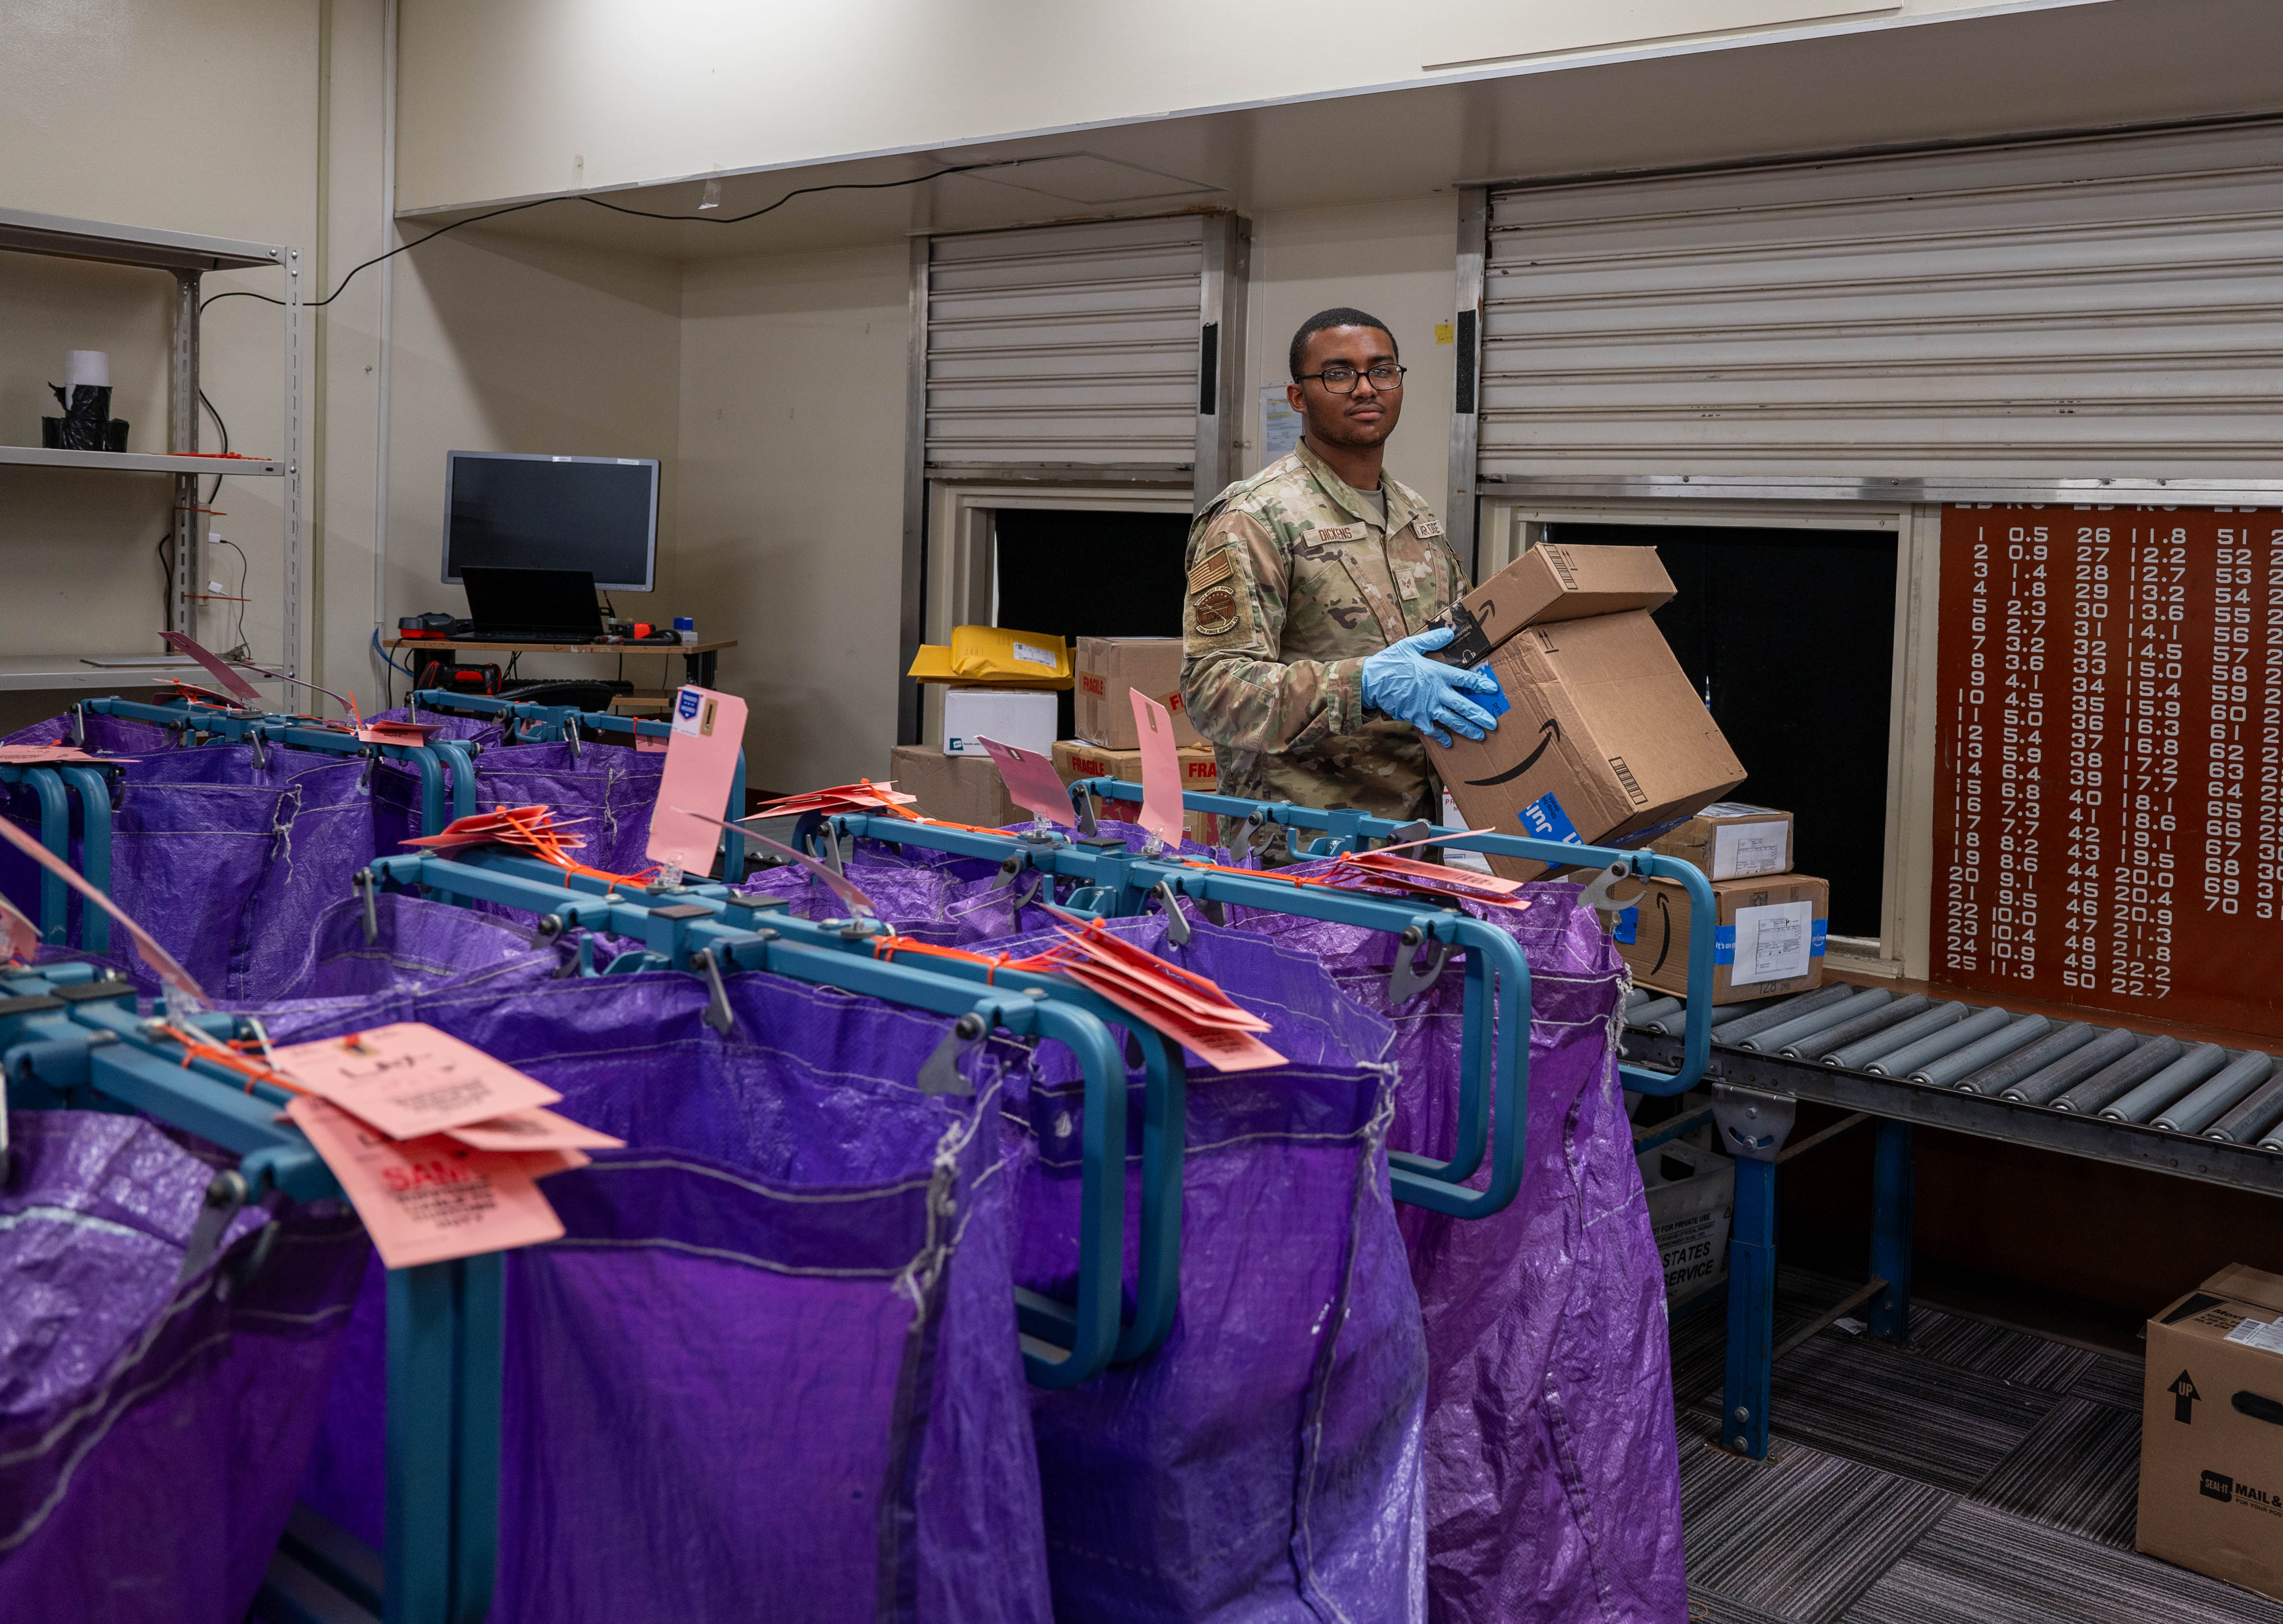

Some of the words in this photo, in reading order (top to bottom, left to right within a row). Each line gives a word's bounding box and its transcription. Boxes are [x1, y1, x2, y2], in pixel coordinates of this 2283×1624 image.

[1318, 528, 1352, 541] DICKENS
[1979, 527, 1983, 541] 1
[2009, 526, 2048, 542] 0.5
[2077, 527, 2111, 543] 26
[2132, 528, 2186, 544] 11.8
[2217, 529, 2247, 545] 51
[1974, 544, 1988, 559] 2
[2009, 544, 2048, 560] 0.9
[2077, 546, 2109, 562] 27
[2131, 547, 2186, 563] 12.2
[2217, 548, 2252, 565] 52
[1974, 562, 1988, 578] 3
[2013, 563, 2047, 579] 1.4
[2076, 564, 2109, 580] 28
[2131, 566, 2186, 582] 12.7
[2216, 568, 2252, 584] 53
[1973, 580, 1987, 595] 4
[2012, 581, 2046, 597] 1.8
[2075, 583, 2108, 599] 29
[2130, 584, 2185, 602] 13.2
[2215, 587, 2251, 603] 54
[1973, 598, 1987, 614] 5
[2007, 600, 2046, 616] 2.3
[2075, 602, 2108, 618] 30
[2129, 603, 2184, 621] 13.6
[2214, 606, 2251, 624] 55
[1972, 617, 1986, 632] 6
[2006, 618, 2046, 634] 2.7
[2074, 621, 2101, 637] 31
[2128, 623, 2177, 640] 14.1
[2214, 626, 2249, 643] 56
[1972, 635, 1986, 650] 7
[2006, 636, 2045, 653] 3.2
[2073, 639, 2107, 656] 32
[2128, 642, 2182, 660] 14.5
[2213, 646, 2249, 663] 57
[1971, 653, 1985, 668] 8
[2005, 654, 2044, 671] 3.6
[2073, 657, 2106, 674] 33
[2127, 661, 2182, 679] 15.0
[2212, 665, 2248, 682] 58
[1083, 676, 1104, 696] FRAGILE
[1971, 671, 1985, 686] 9
[2005, 673, 2038, 689] 4.1
[2072, 677, 2105, 694] 34
[2127, 680, 2181, 698] 15.4
[2212, 684, 2247, 702] 59
[1959, 688, 1984, 704] 10
[2005, 692, 2043, 708] 4.5
[2072, 695, 2105, 712] 35
[2126, 699, 2180, 717] 15.9
[2211, 704, 2246, 721] 60
[1958, 706, 1978, 722] 11
[2004, 709, 2043, 726] 5.0
[2071, 713, 2104, 731] 36
[2125, 718, 2179, 736] 16.3
[2210, 723, 2239, 741] 61
[1958, 724, 1982, 741] 12
[2003, 727, 2042, 745] 5.4
[2071, 732, 2103, 749] 37
[2124, 737, 2179, 755] 16.8
[2210, 742, 2244, 761] 62
[1072, 756, 1105, 777] FRAGILE
[1957, 742, 1982, 758] 13
[2003, 745, 2041, 763] 5.9
[2070, 751, 2102, 768] 38
[2124, 755, 2178, 774] 17.2
[2209, 762, 2244, 780] 63
[1956, 760, 1982, 776] 14
[2002, 764, 2041, 781] 6.4
[2070, 769, 2102, 787] 39
[2123, 774, 2177, 792] 17.7
[2208, 781, 2243, 799] 64
[1956, 778, 1981, 794] 15
[2001, 782, 2040, 800] 6.8
[2069, 789, 2101, 806] 40
[2123, 793, 2172, 812] 18.1
[2207, 801, 2242, 819] 65
[1526, 801, 1553, 833] Jul
[1956, 796, 1981, 812] 16
[2001, 800, 2040, 818] 7.3
[2069, 808, 2095, 824] 41
[2122, 812, 2176, 831] 18.6
[2207, 820, 2241, 837] 66
[1955, 813, 1981, 829] 17
[2001, 818, 2039, 835] 7.7
[2068, 826, 2100, 842] 42
[2122, 830, 2170, 850] 19.1
[2206, 839, 2241, 857] 67
[1955, 831, 1979, 847] 18
[2000, 835, 2039, 855] 8.2
[2068, 844, 2100, 860] 43
[2121, 848, 2174, 869] 19.5
[2205, 858, 2239, 876] 68
[1954, 849, 1979, 865] 19
[2000, 854, 2038, 872] 8.6
[2067, 862, 2099, 879] 44
[2115, 867, 2174, 888] 20.0
[2205, 877, 2239, 895] 69
[1949, 866, 1979, 882] 20
[2000, 872, 2032, 889] 9.1
[2067, 881, 2098, 898] 45
[2115, 885, 2172, 906] 20.4
[2204, 895, 2238, 914] 70
[1949, 883, 1974, 900] 21
[1999, 889, 2037, 908] 9.5
[2066, 899, 2097, 916] 46
[2114, 904, 2172, 926] 20.9
[1949, 901, 1978, 919] 22
[1992, 906, 2037, 926] 10.0
[2065, 917, 2097, 933] 47
[2113, 923, 2171, 944] 21.3
[1812, 934, 1825, 943] prime
[1948, 918, 1977, 935] 23
[1992, 924, 2036, 943] 10.4
[2065, 935, 2096, 952] 48
[2113, 941, 2170, 962] 21.8
[1947, 936, 1977, 953] 24
[1992, 941, 2035, 962] 10.9
[2064, 953, 2096, 970] 49
[2112, 959, 2170, 982] 22.2
[1947, 953, 1977, 970] 25
[1991, 960, 2034, 979] 11.3
[2063, 971, 2095, 989] 50
[2111, 978, 2170, 999] 22.7
[1653, 1226, 1661, 1235] OT
[1661, 1224, 1673, 1233] FOR
[1675, 1217, 1698, 1230] PRIVATE
[1699, 1213, 1711, 1223] USE
[1663, 1241, 1711, 1268] STATES
[2179, 1382, 2193, 1397] UP
[2236, 1483, 2270, 1505] MAIL
[2271, 1495, 2283, 1508] &
[2236, 1498, 2248, 1507] FOR
[2250, 1503, 2268, 1513] YOUR
